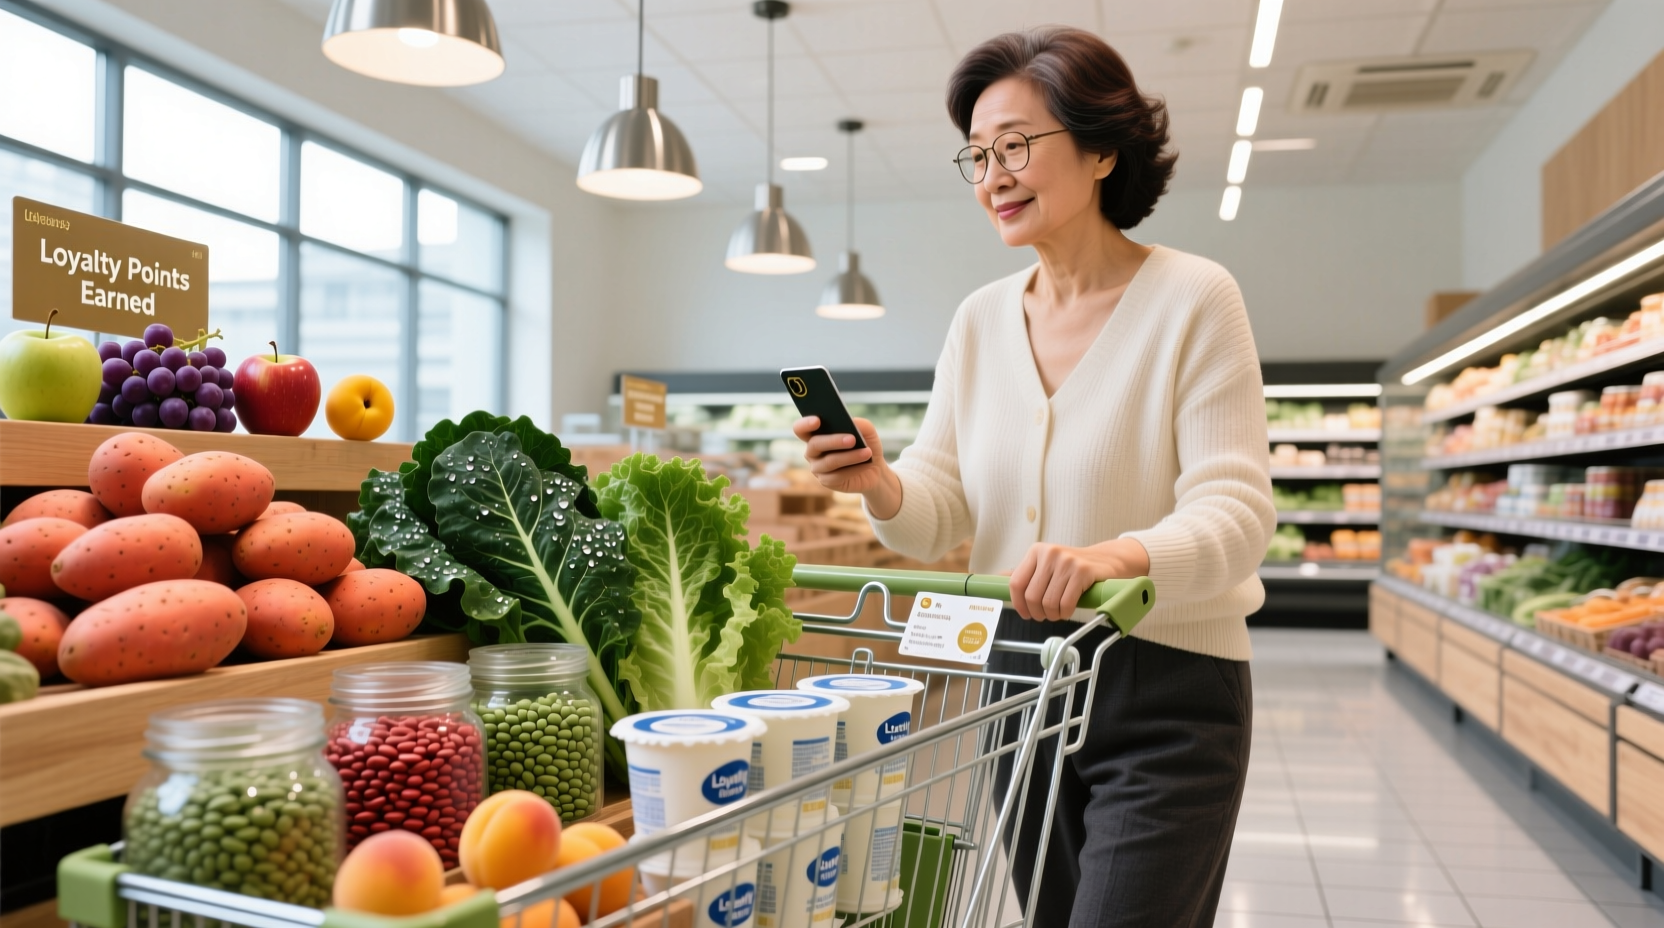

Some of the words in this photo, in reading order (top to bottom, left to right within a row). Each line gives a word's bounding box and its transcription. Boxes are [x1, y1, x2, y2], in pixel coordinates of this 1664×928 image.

[40, 238, 121, 283] Loyalty
[128, 257, 190, 291] Points
[81, 280, 155, 316] Earned
